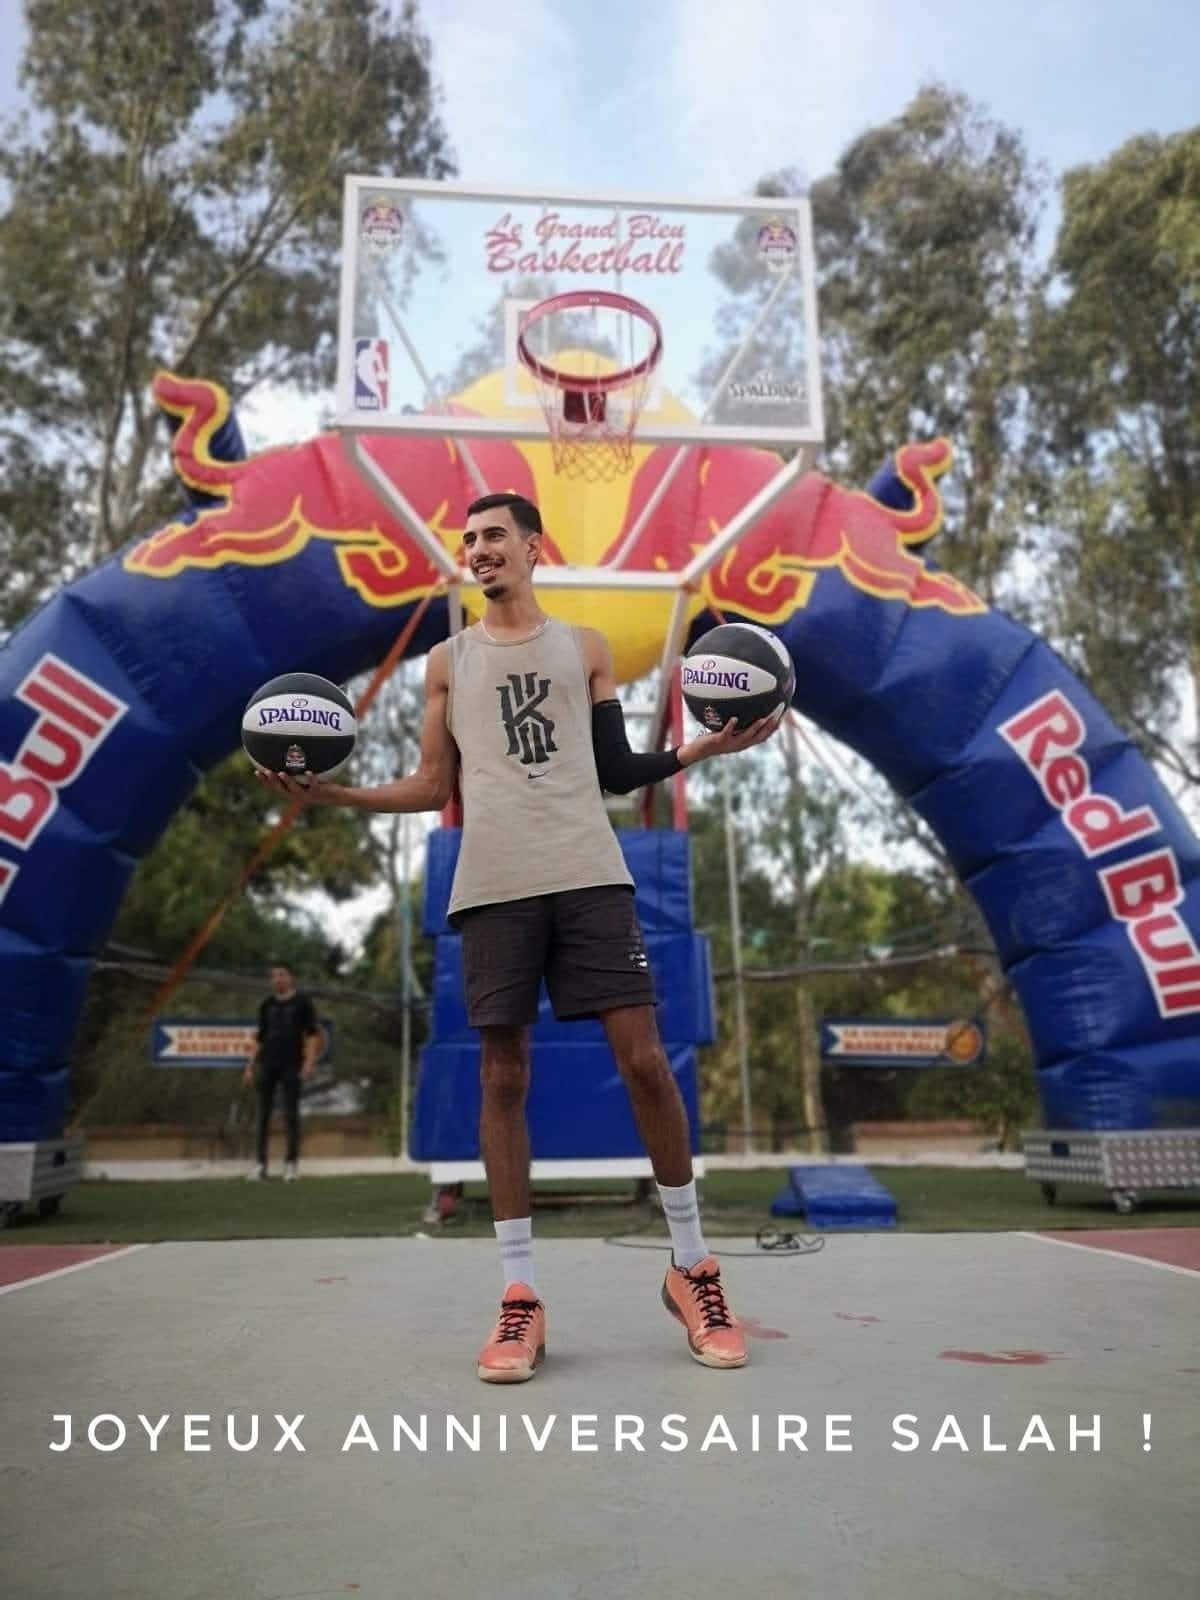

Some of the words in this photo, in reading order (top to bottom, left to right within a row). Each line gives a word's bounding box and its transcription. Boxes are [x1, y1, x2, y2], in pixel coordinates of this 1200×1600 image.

[484, 213, 522, 238] Le
[535, 213, 618, 246] Grand
[627, 214, 685, 239] Bleu
[485, 238, 685, 273] Basketball
[258, 708, 342, 732] SPALDING
[996, 689, 1163, 859] Red
[1097, 848, 1200, 1018] Bull
